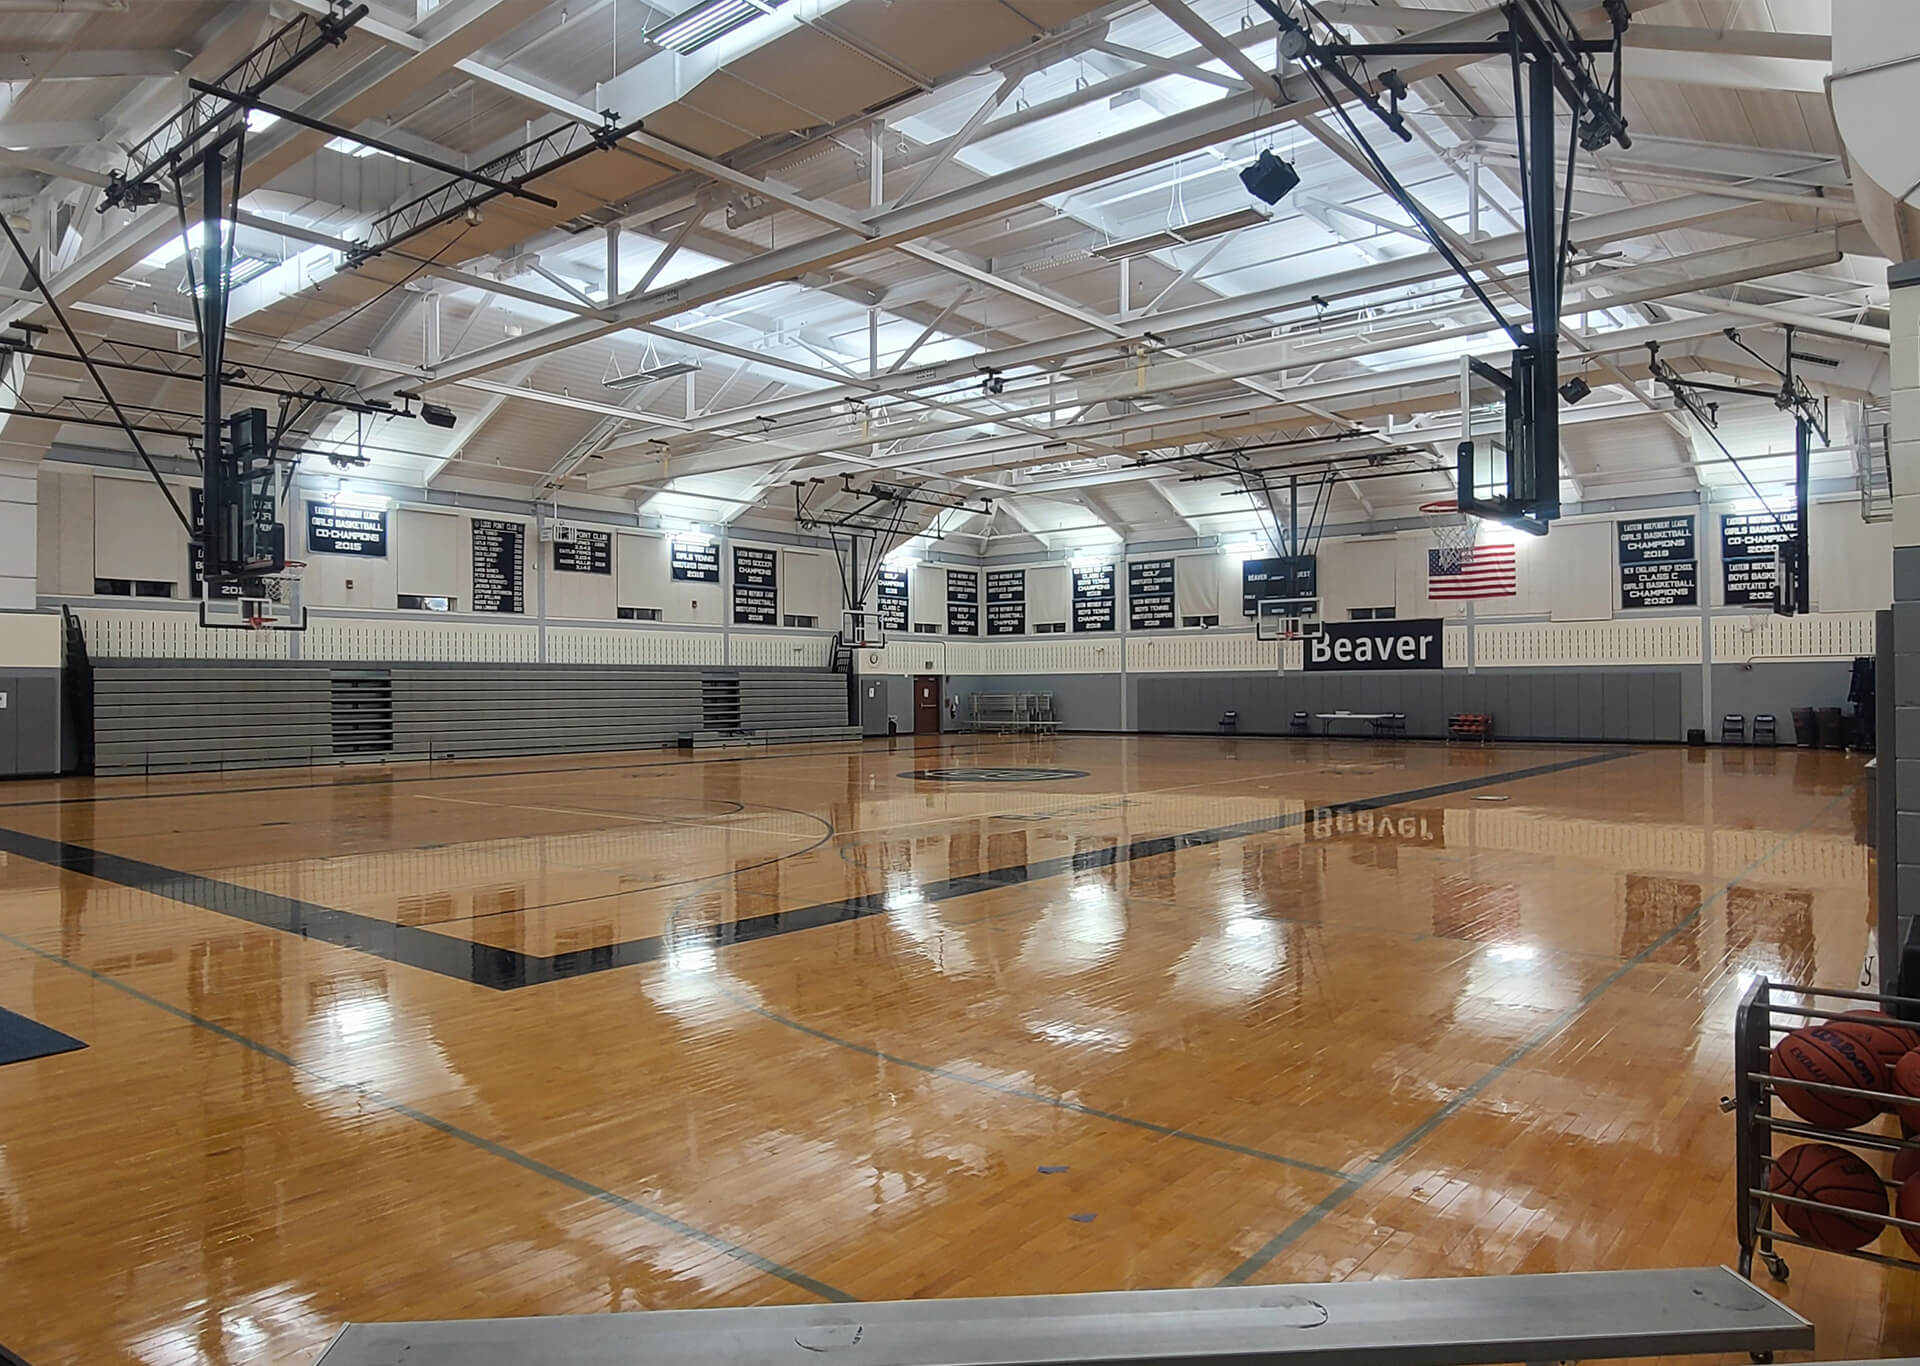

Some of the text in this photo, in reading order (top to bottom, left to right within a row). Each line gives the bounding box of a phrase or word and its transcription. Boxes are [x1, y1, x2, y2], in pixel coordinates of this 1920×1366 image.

[1644, 529, 1692, 539] BASKETBALL
[1628, 539, 1685, 550] CHAMPIONS
[1639, 572, 1679, 581] CLASS C
[1646, 580, 1695, 590] BASKETBALL
[1629, 588, 1688, 598] CHAMPIONS
[1644, 596, 1674, 605] 2020
[1312, 632, 1433, 662] Beaver
